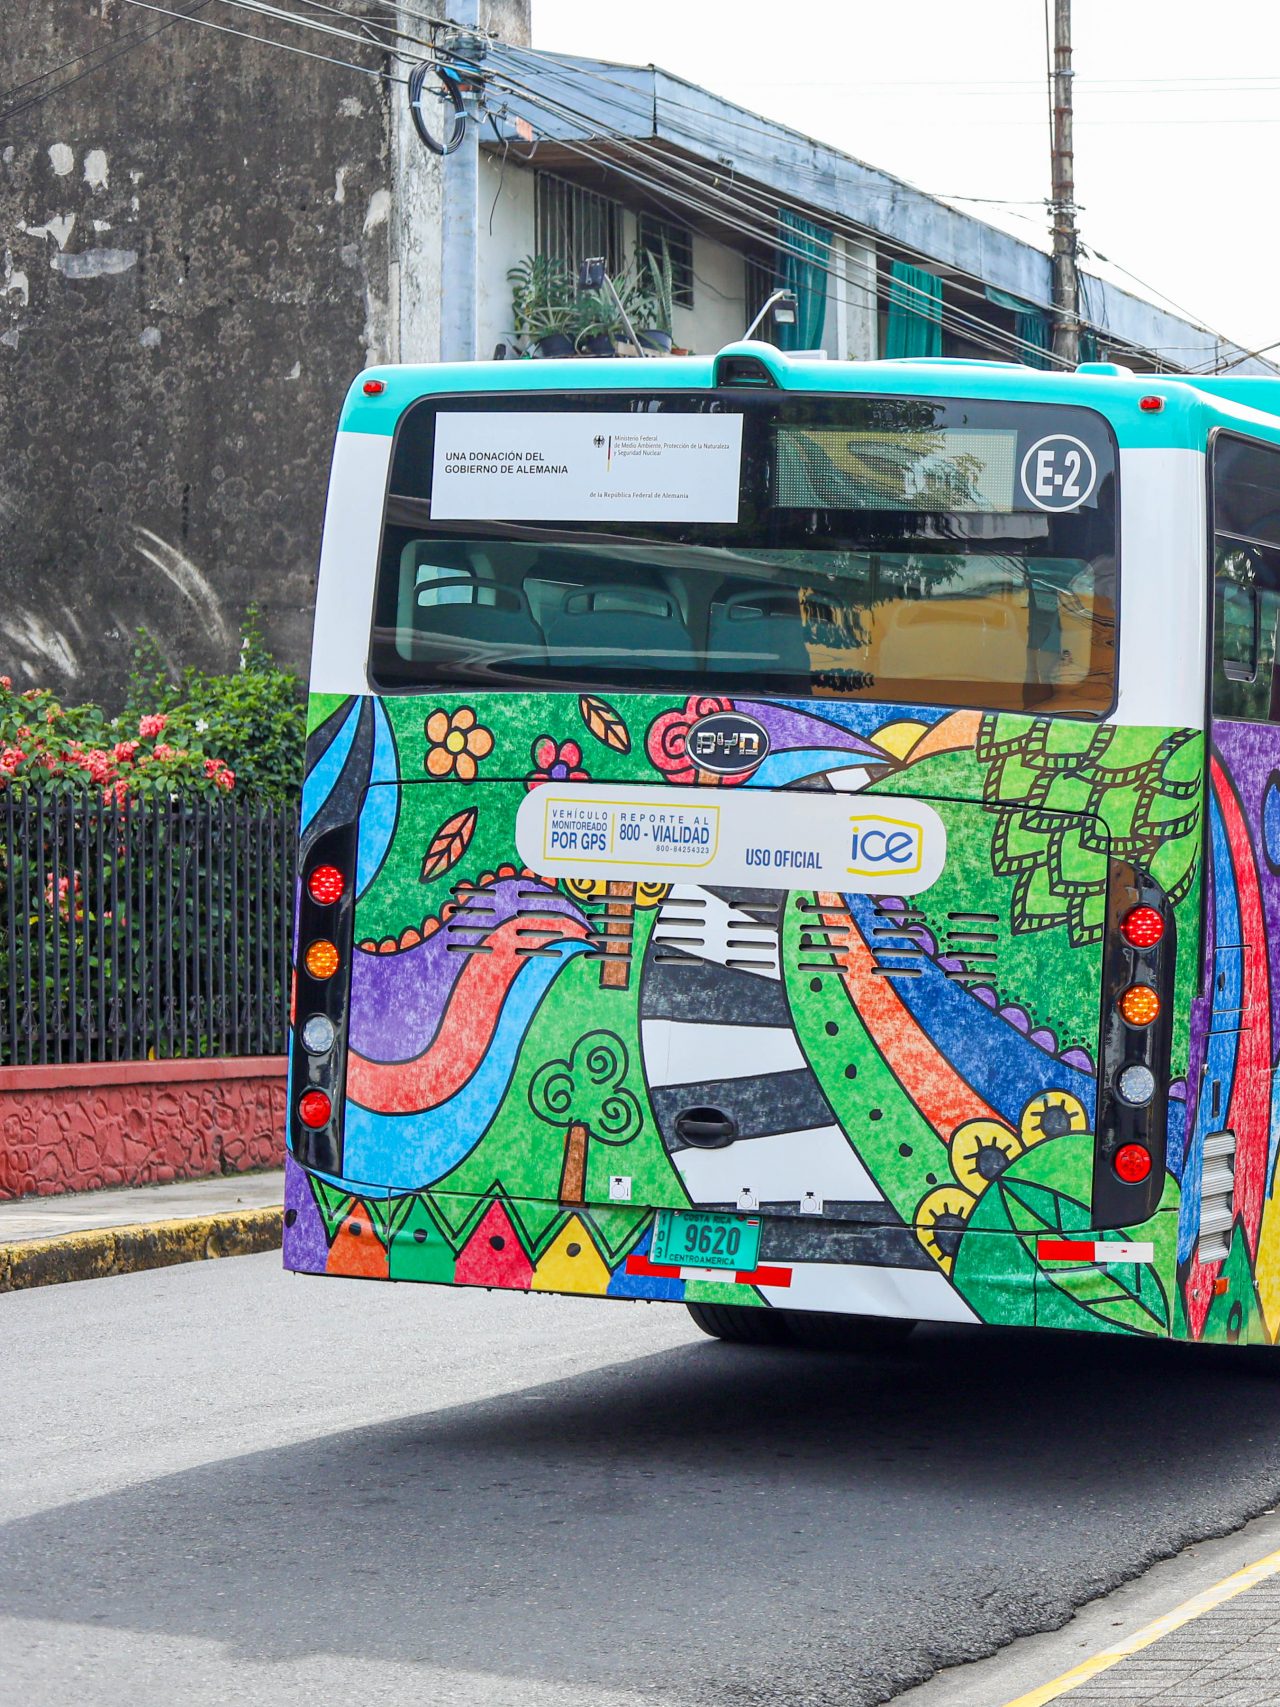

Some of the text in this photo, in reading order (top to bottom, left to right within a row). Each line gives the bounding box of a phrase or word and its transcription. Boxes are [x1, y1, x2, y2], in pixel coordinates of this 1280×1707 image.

[445, 450, 545, 461] UNA DONACIÓN DEL
[444, 465, 569, 474] GOBIERNO DE ALEMANIA
[1035, 450, 1081, 498] E-2
[696, 732, 759, 756] BYD
[552, 808, 608, 820] VEHÍCULO
[620, 813, 709, 825] REPORTE AL
[552, 820, 607, 832] MONITOREADO
[619, 823, 640, 841] 800
[652, 825, 710, 844] VIALIDAD
[551, 831, 606, 851] POR GPS
[851, 826, 914, 863] ice
[655, 844, 710, 854] 800-84254323
[745, 848, 823, 869] USO OFICIAL
[683, 1213, 732, 1225] COSTA RICA
[684, 1223, 742, 1256] 9620
[669, 1253, 735, 1266] CENTROAMERICA
